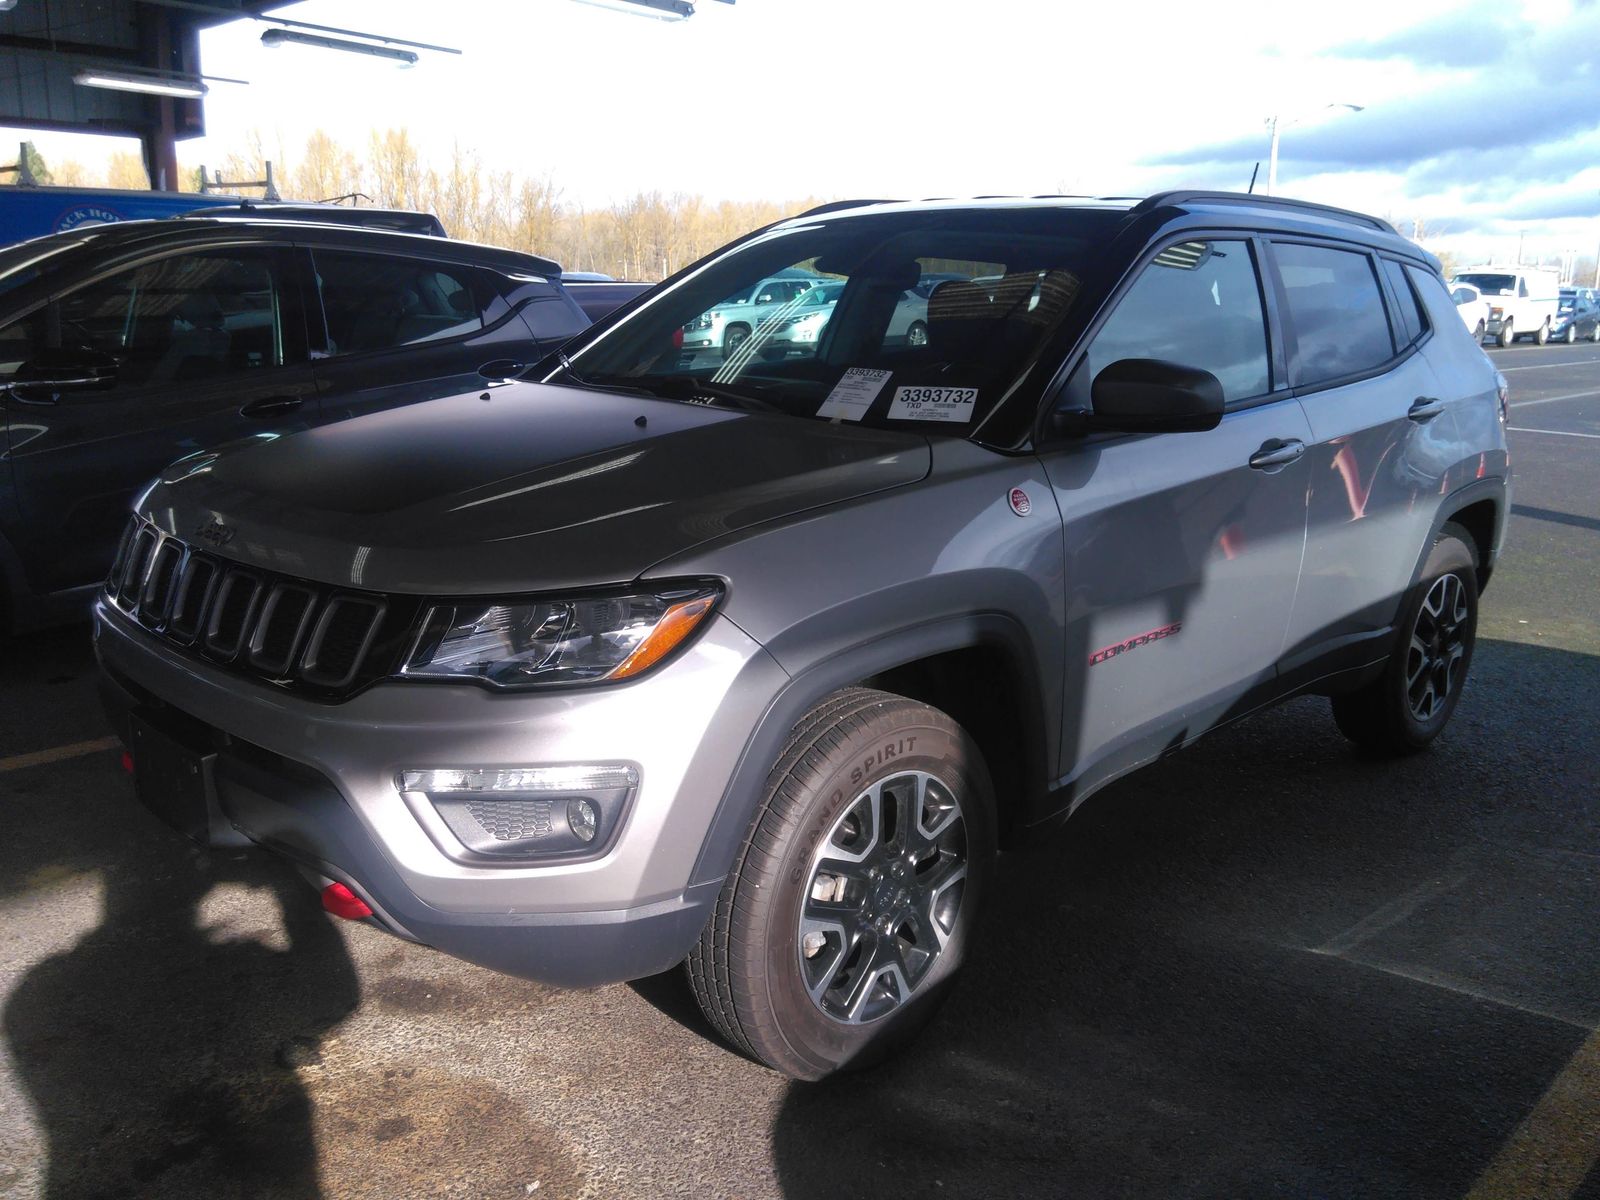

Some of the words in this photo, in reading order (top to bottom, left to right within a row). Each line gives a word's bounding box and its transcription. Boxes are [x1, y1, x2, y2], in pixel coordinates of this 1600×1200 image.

[58, 210, 86, 233] ACK
[900, 388, 975, 404] 3393732
[1089, 621, 1182, 667] COMPASS
[790, 788, 844, 885] GRAND
[851, 736, 917, 785] SPIRIT
